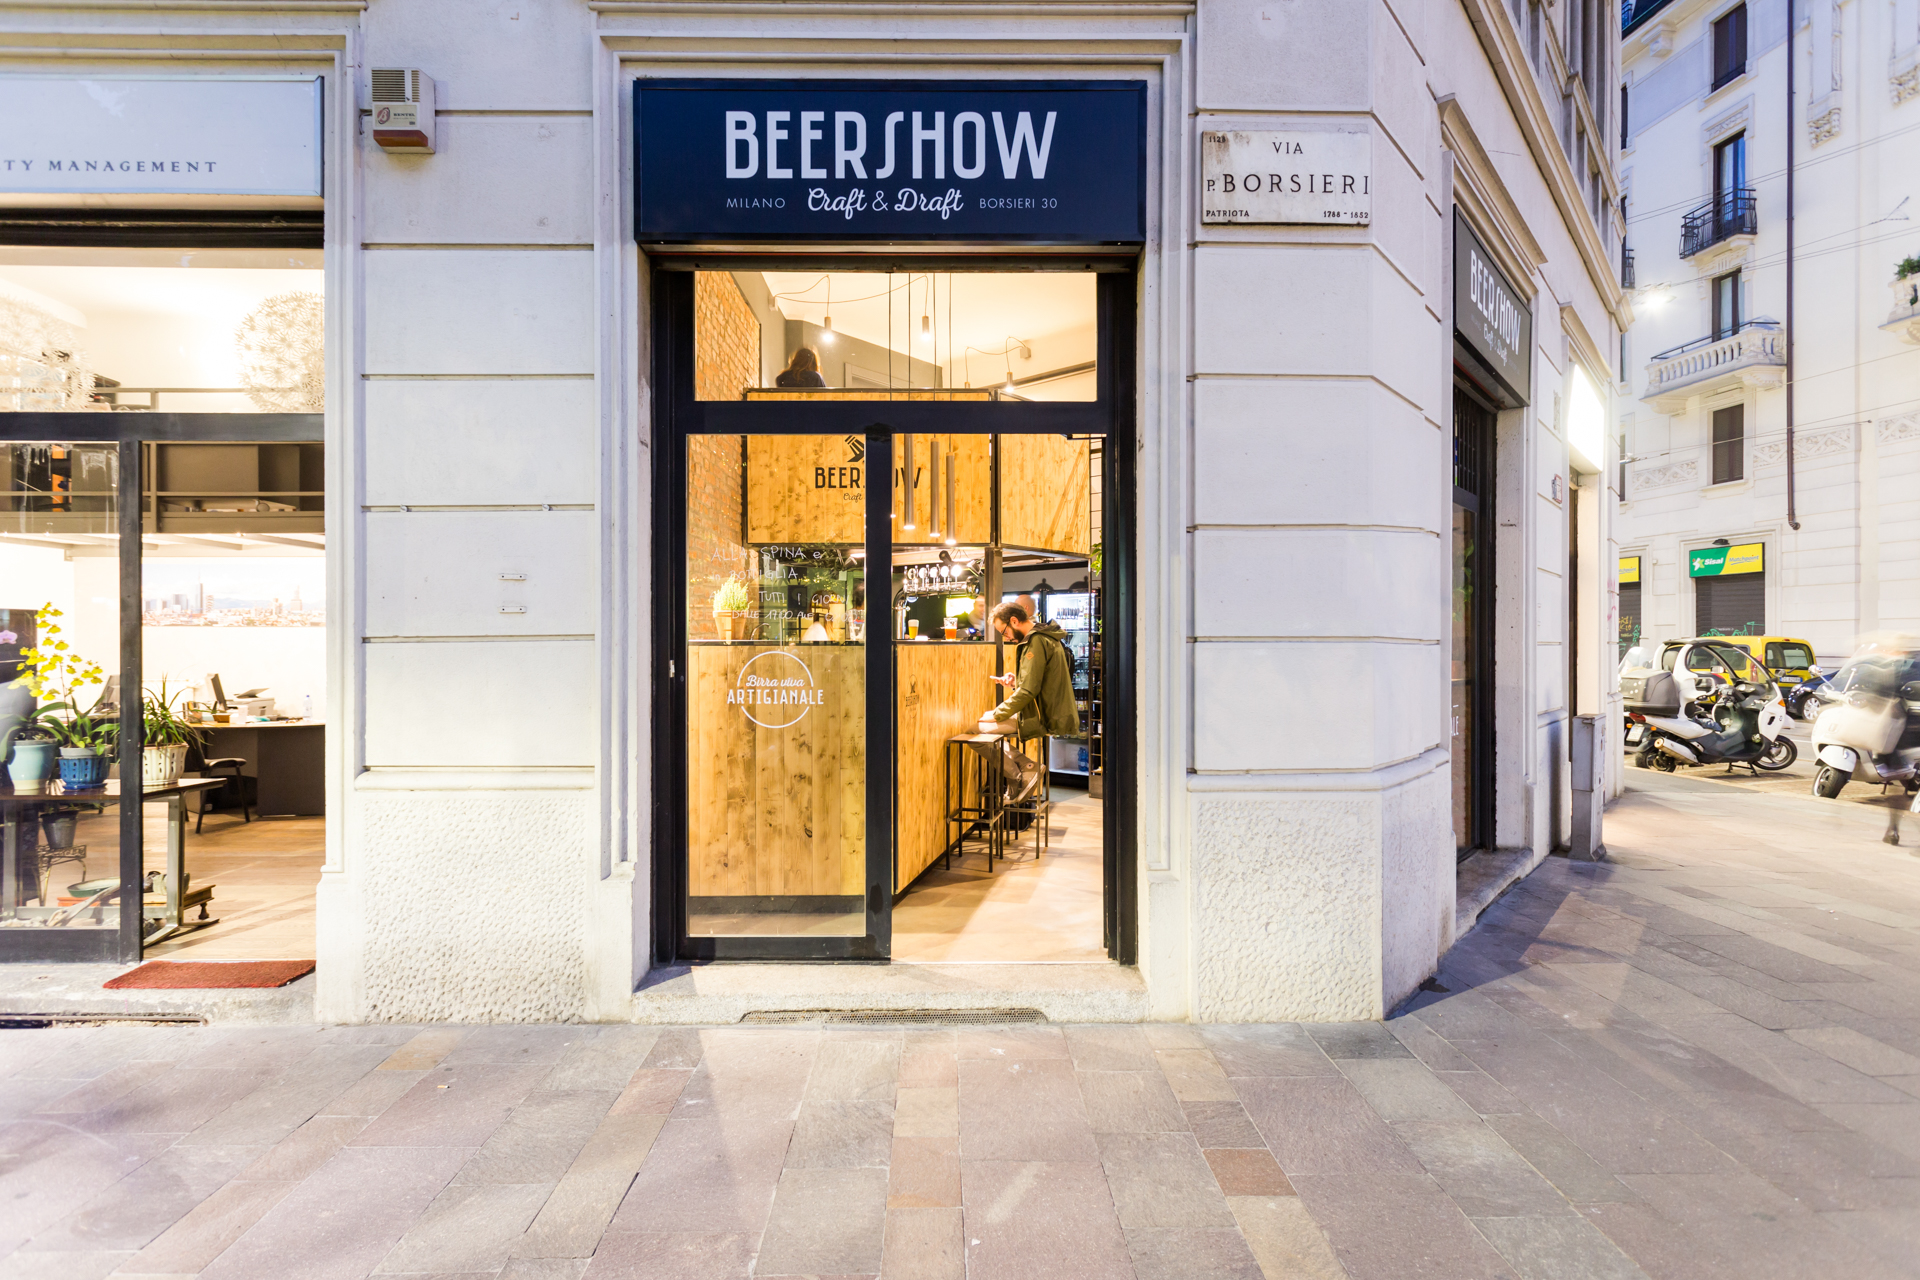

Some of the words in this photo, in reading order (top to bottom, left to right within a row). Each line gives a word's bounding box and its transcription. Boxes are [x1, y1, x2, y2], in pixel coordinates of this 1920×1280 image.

[726, 111, 1057, 179] BEERSHOW
[1272, 142, 1304, 155] VIA
[0, 160, 33, 171] TY
[49, 160, 217, 173] MANAGEMENT
[1207, 179, 1216, 192] P.
[1222, 173, 1370, 195] BORSIERI
[726, 198, 786, 209] MILANO
[808, 188, 867, 220] Craft
[872, 190, 889, 211] &
[894, 188, 964, 220] Draft
[979, 198, 1035, 209] BORSIERI
[1041, 198, 1058, 209] 30
[1206, 209, 1250, 217] PATRIOTA
[1470, 249, 1521, 355] BEERSHOW
[711, 547, 748, 562] ALLA
[760, 545, 807, 560] SPINA
[1704, 557, 1724, 566] Sisal
[729, 567, 799, 581] BOTTIGLIA
[759, 591, 785, 604] TUTTI
[746, 675, 779, 687] Birra
[781, 677, 806, 687] viva
[727, 689, 825, 704] ARTIGIANALE
